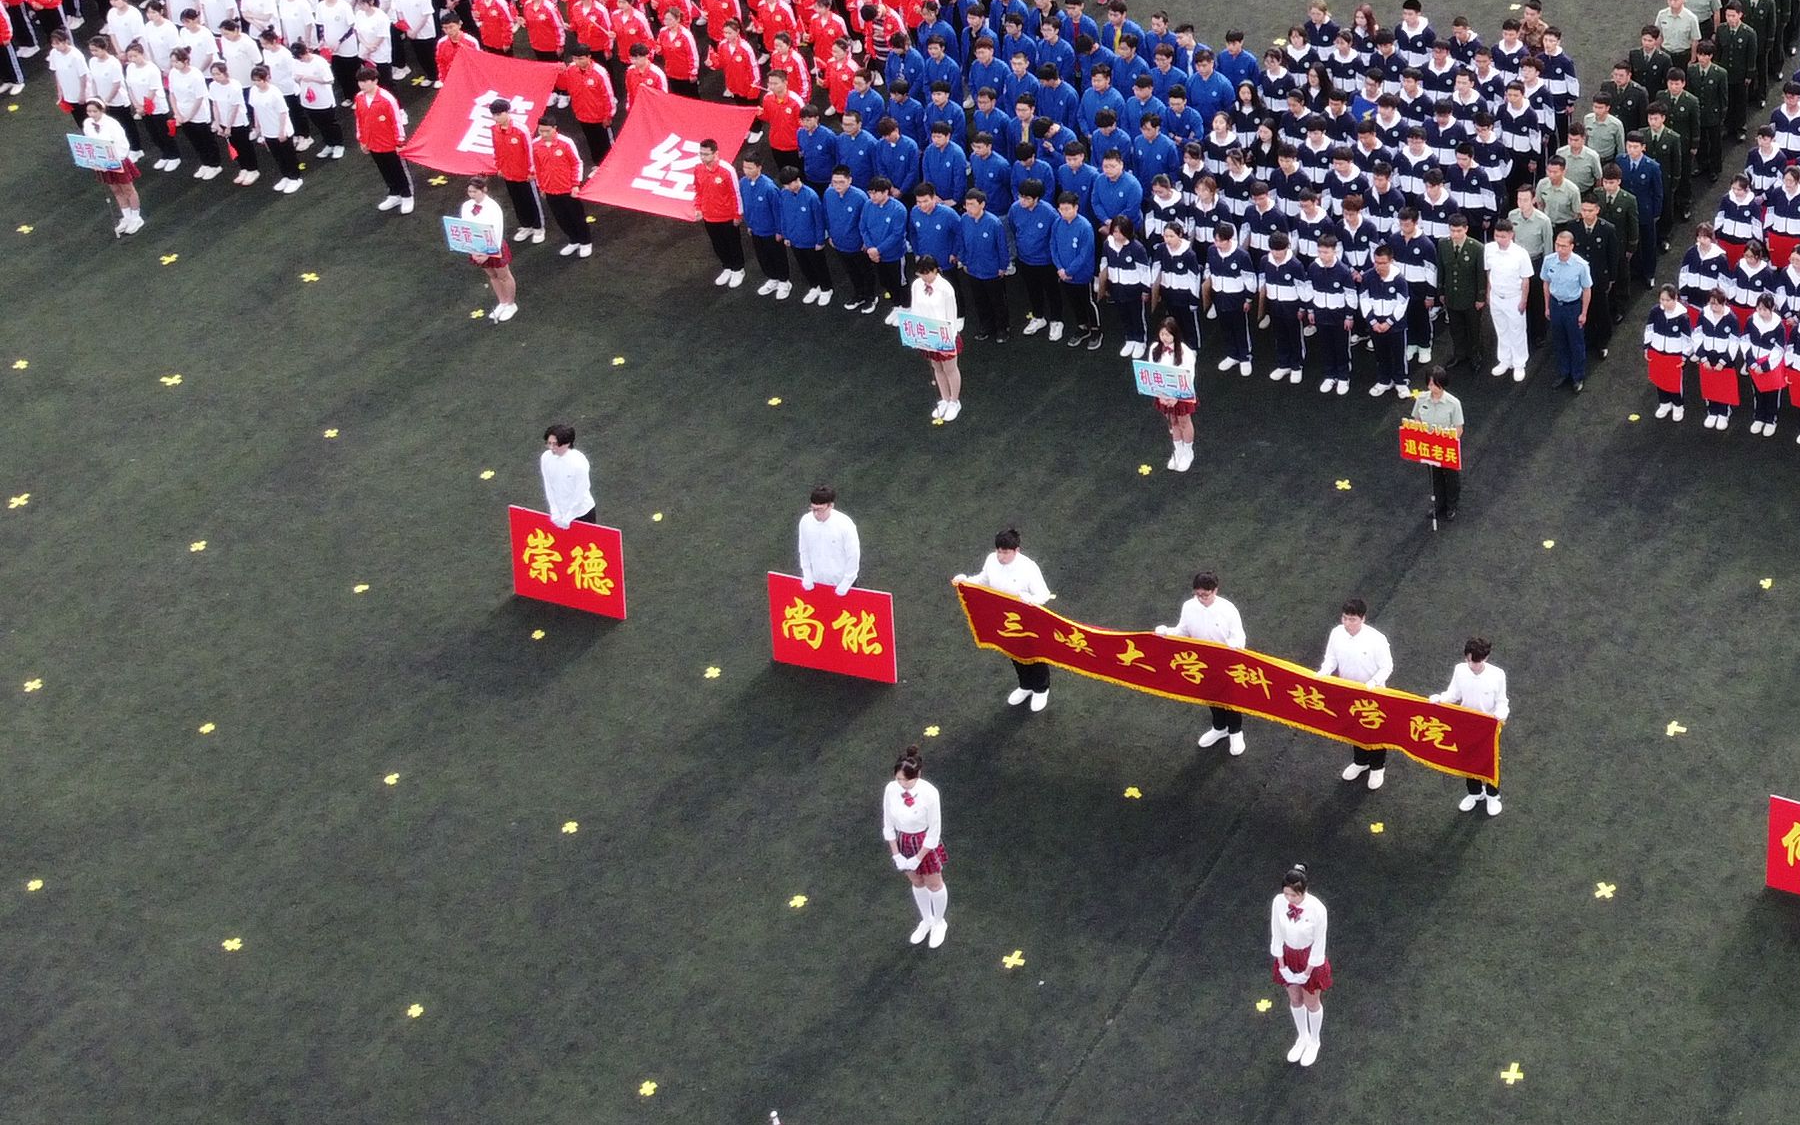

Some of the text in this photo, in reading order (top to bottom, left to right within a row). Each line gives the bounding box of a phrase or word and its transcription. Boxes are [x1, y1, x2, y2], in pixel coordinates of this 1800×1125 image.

[631, 132, 702, 201] 经
[903, 319, 953, 344] 机电一队
[1139, 368, 1192, 393] 机电二队
[1404, 438, 1458, 464] 退伍老兵
[522, 527, 615, 597] 崇德
[782, 596, 884, 657] 尚能
[996, 611, 1459, 753] 三峡大学科技学院
